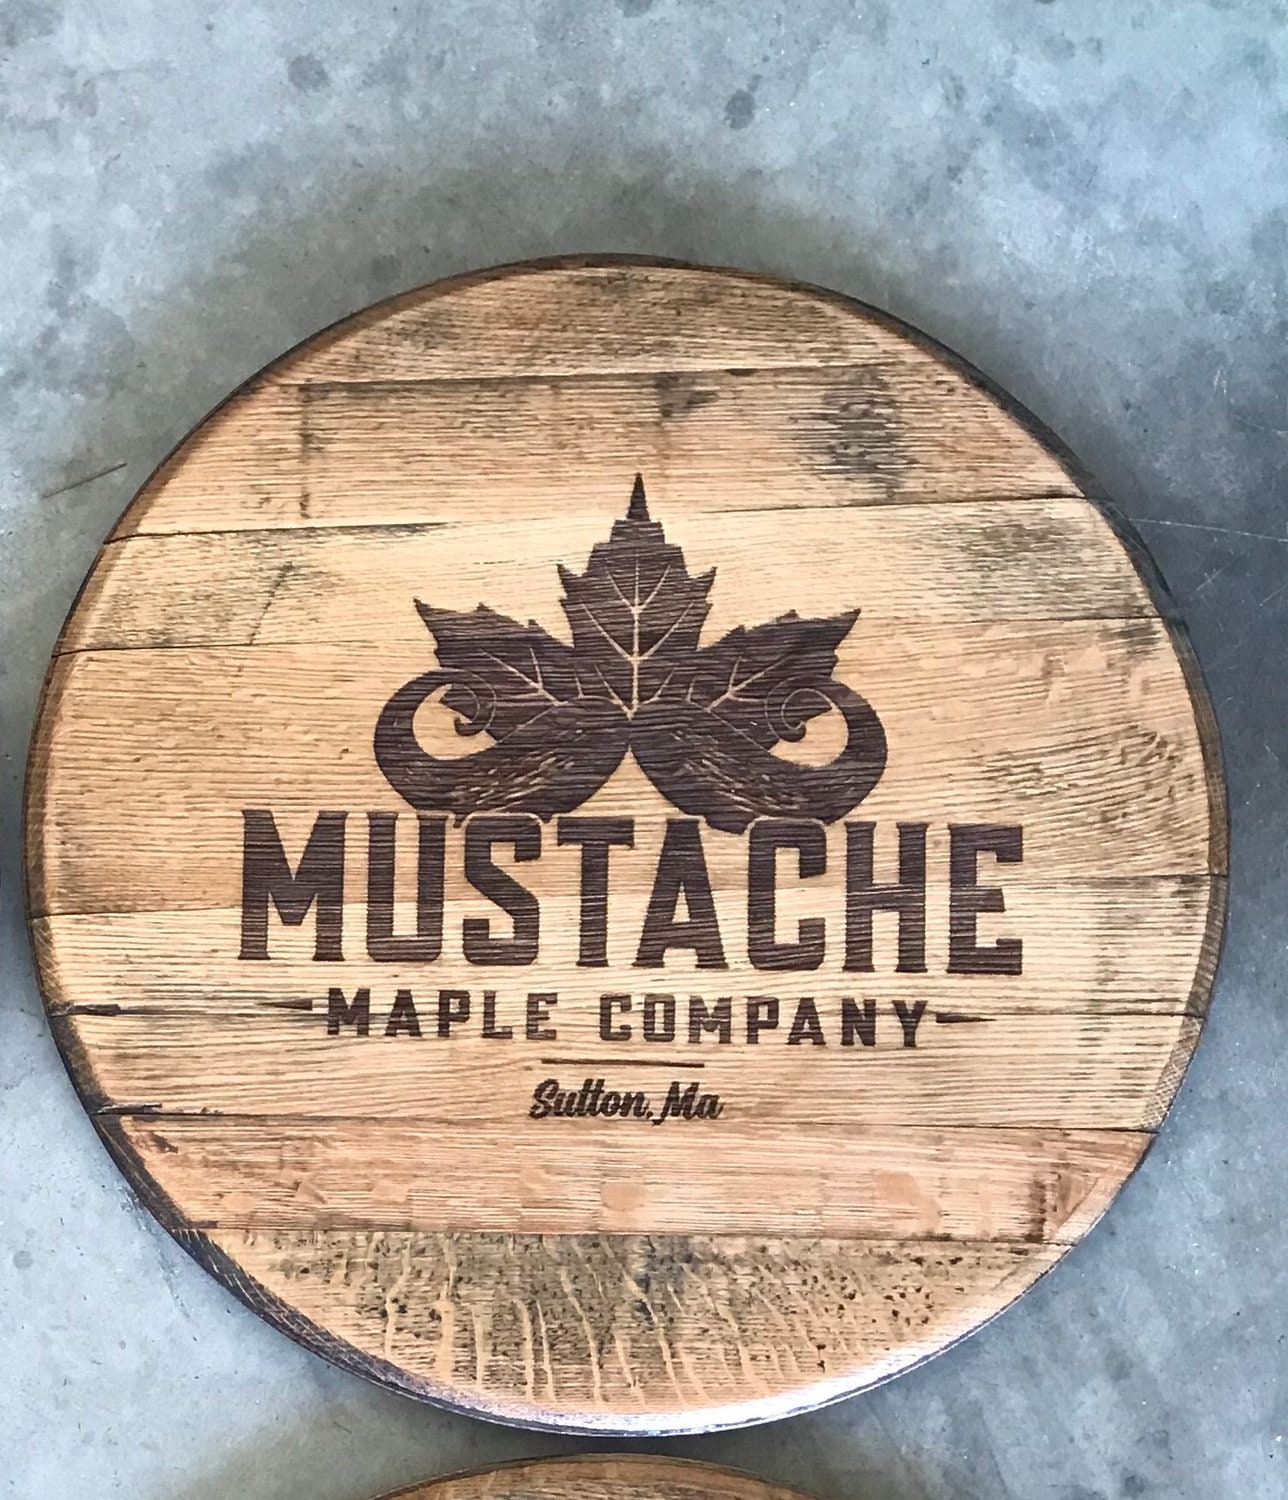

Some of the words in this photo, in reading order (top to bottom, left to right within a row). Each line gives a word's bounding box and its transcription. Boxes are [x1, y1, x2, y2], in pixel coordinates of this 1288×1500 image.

[237, 808, 1025, 976] MUSTACHE
[326, 987, 559, 1041] MAPLE
[598, 993, 928, 1048] COMPANY
